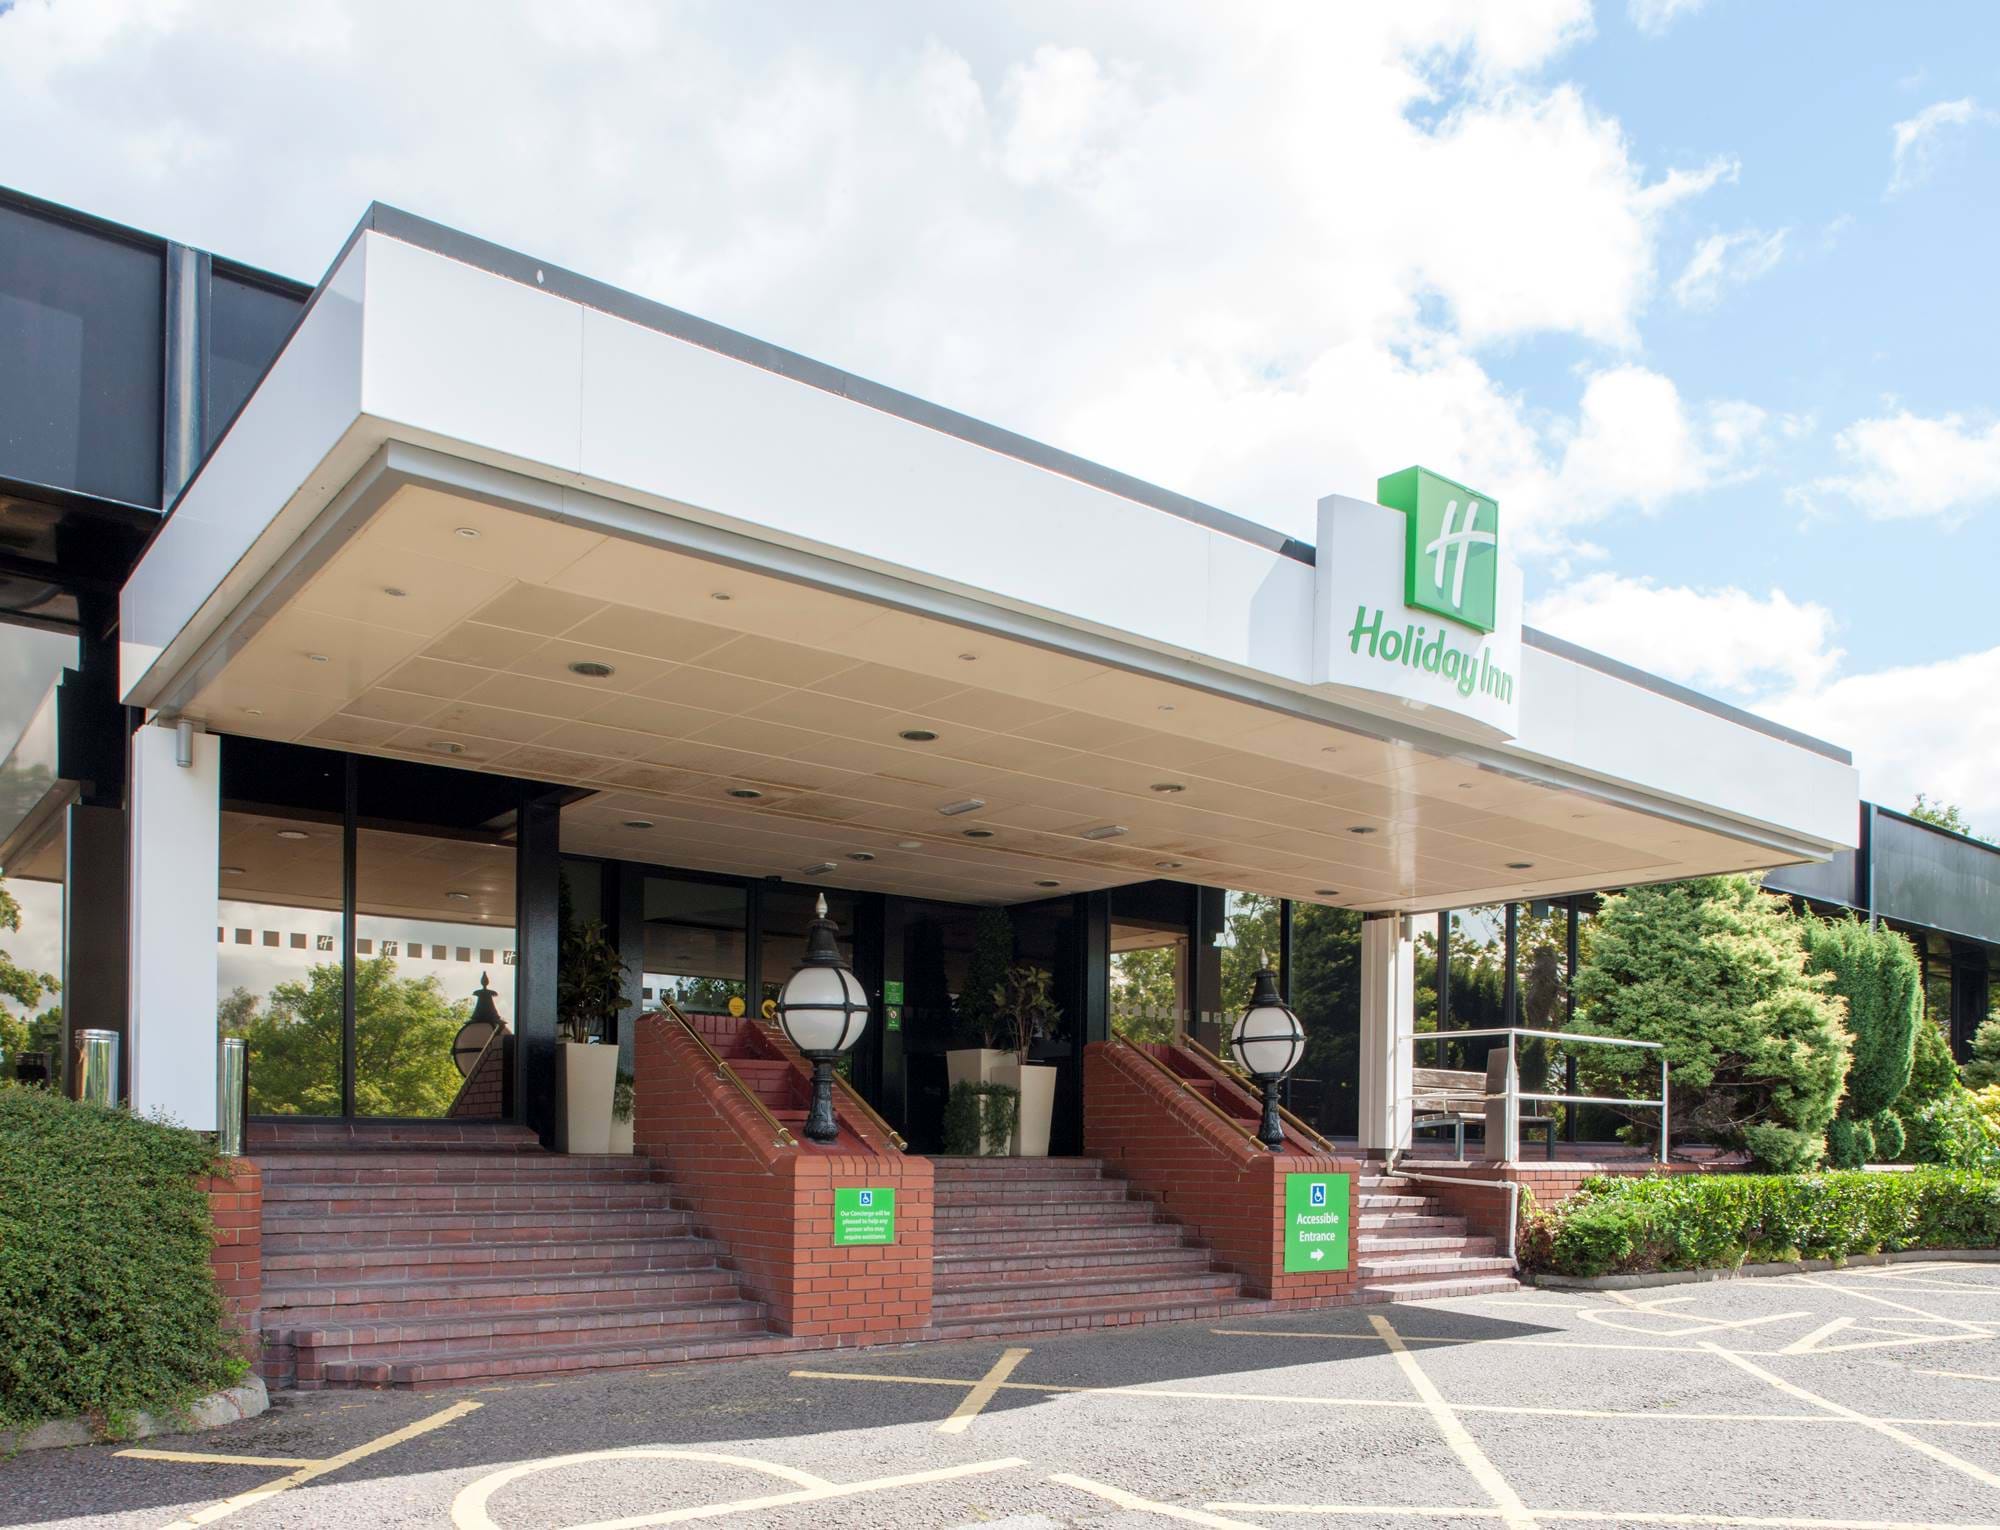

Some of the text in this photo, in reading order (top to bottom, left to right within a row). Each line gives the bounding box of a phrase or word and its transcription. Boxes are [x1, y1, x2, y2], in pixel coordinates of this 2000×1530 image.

[1348, 605, 1513, 704] Holiday Inn
[1296, 1212, 1338, 1224] Accessible
[1299, 1230, 1336, 1242] Entrance
